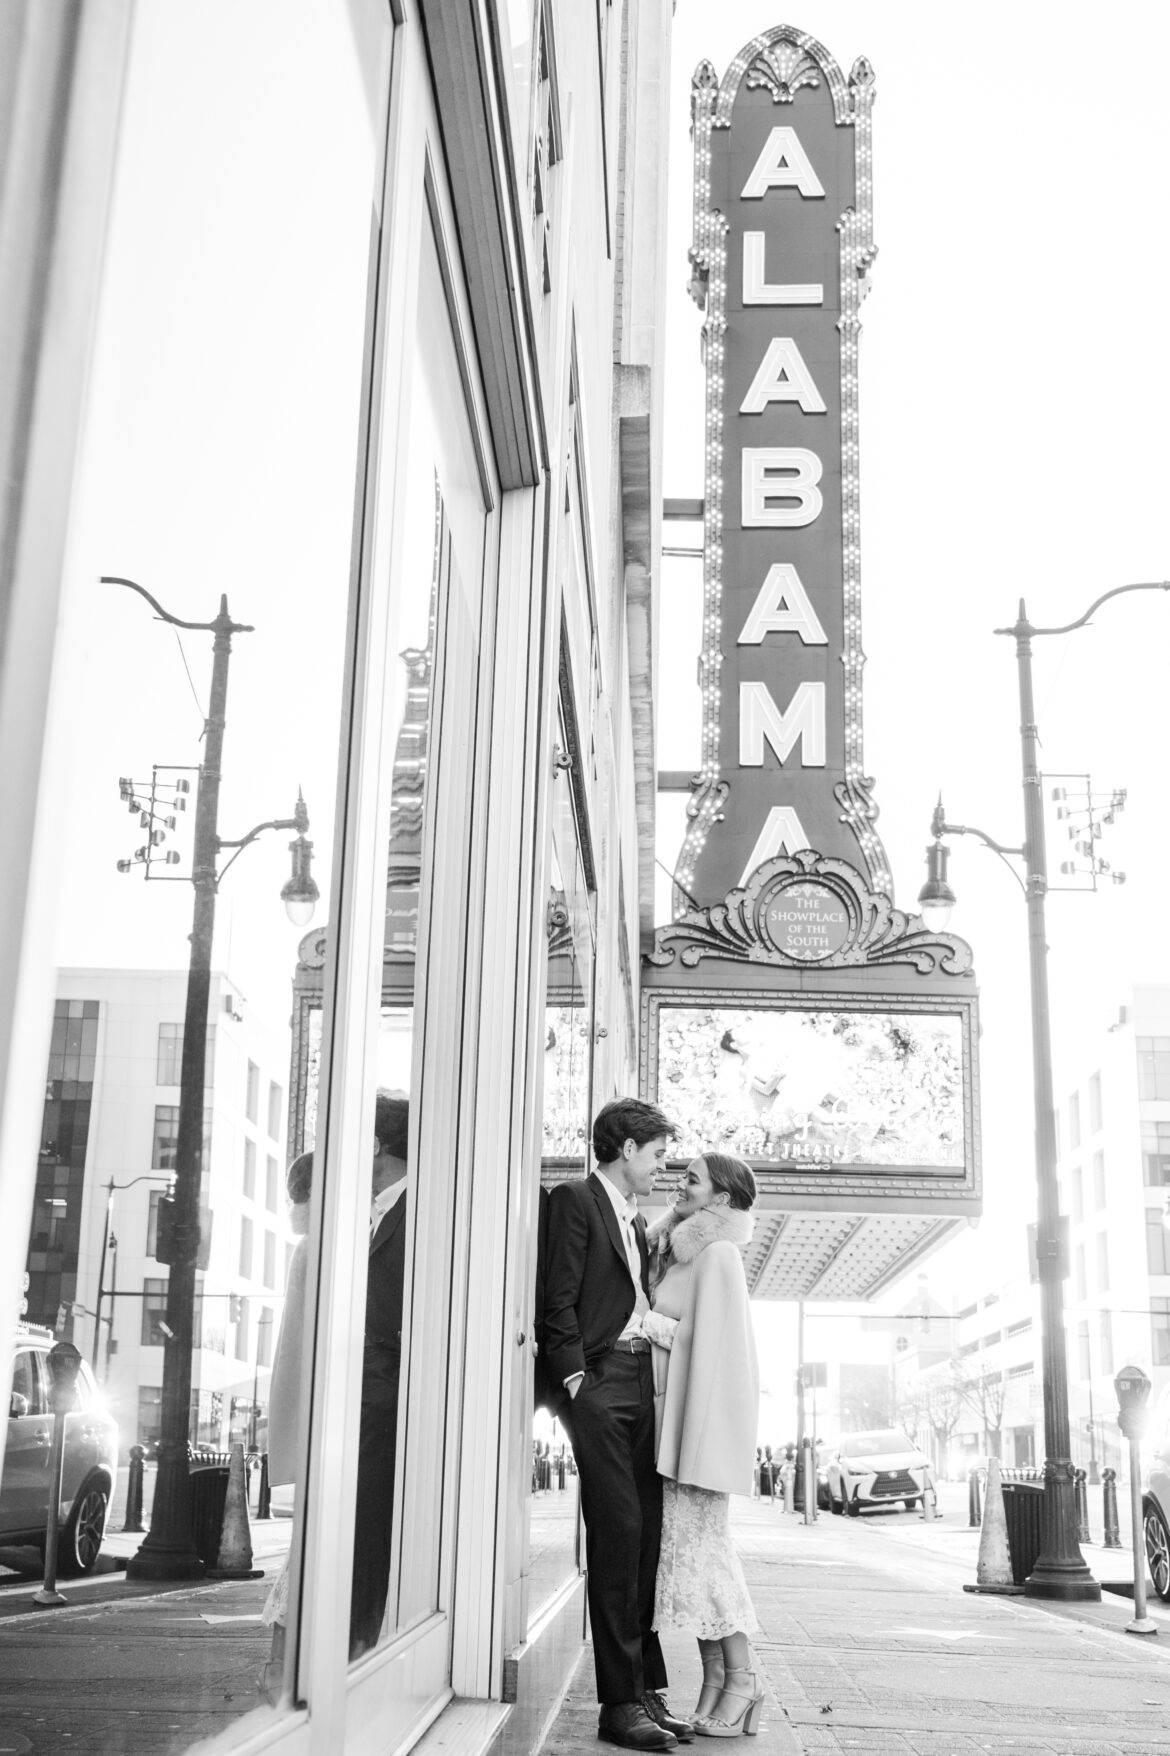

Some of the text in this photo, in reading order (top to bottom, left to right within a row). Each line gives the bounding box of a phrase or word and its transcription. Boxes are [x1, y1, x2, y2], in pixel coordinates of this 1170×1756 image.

[737, 126, 828, 889] ALABAMA
[796, 897, 820, 909] THE
[770, 910, 845, 923] SHOWPLACE
[788, 924, 827, 934] OF THE
[786, 935, 829, 947] SOUTH
[718, 1142, 774, 1155] BALLET
[783, 1143, 850, 1158] THEATRE
